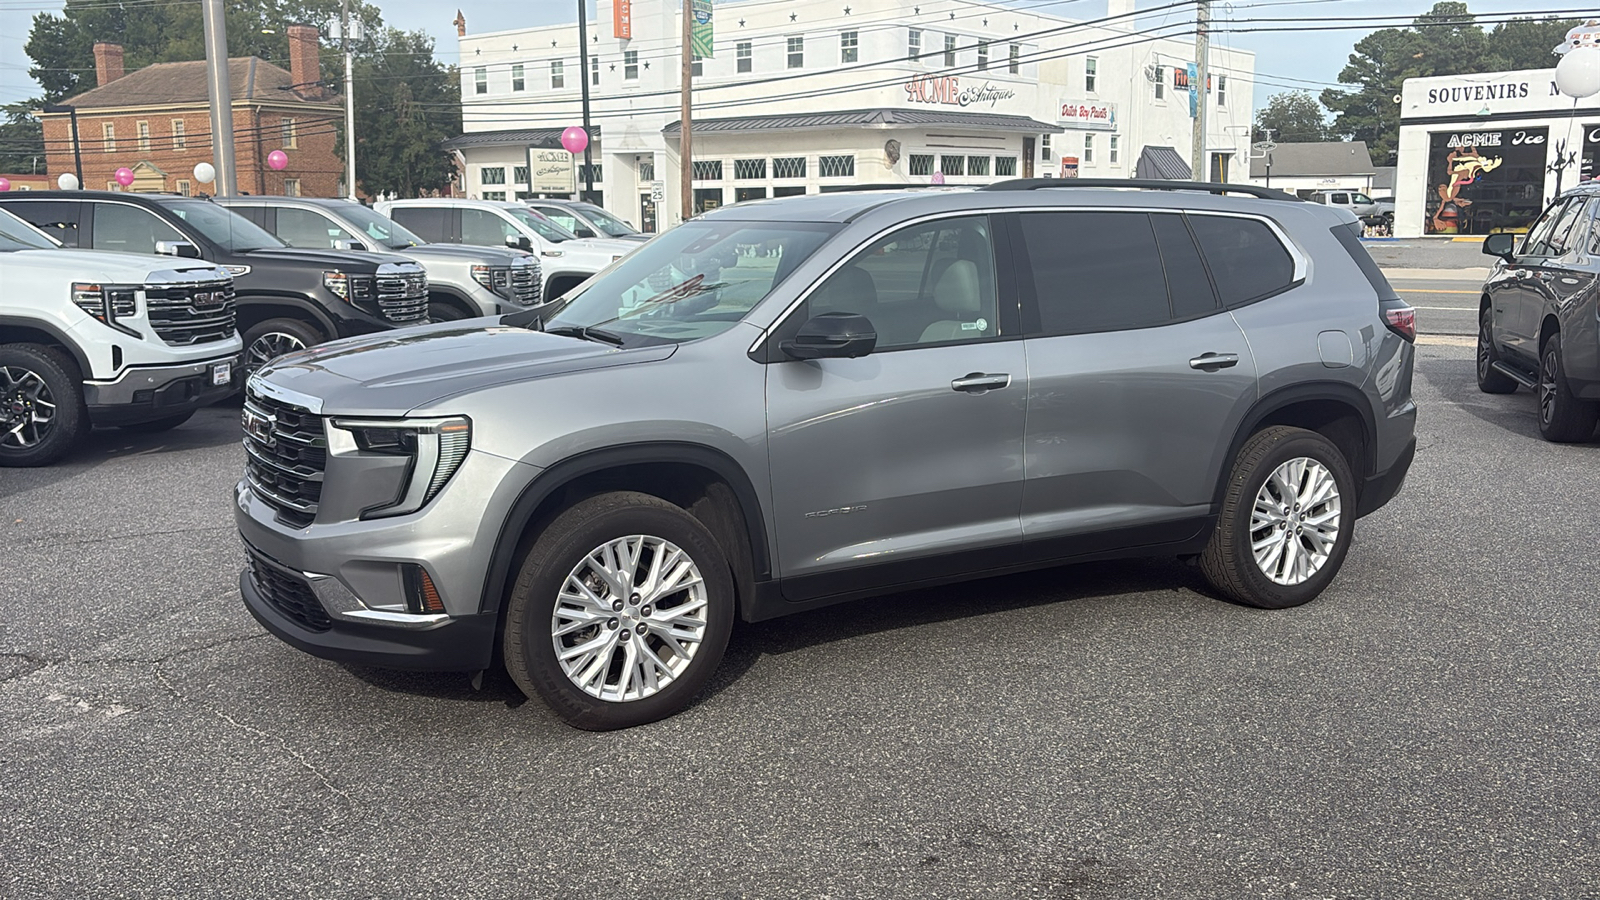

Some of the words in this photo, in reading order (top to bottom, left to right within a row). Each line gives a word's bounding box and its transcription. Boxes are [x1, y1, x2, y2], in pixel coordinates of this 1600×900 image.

[905, 73, 959, 105] ACME
[971, 80, 1016, 108] Antiques
[1428, 82, 1529, 104] SOUVENIRS
[1062, 104, 1077, 117] Dutch
[1079, 105, 1089, 120] Boy
[1090, 106, 1107, 119] Paints
[1447, 133, 1502, 148] ACME
[1511, 131, 1546, 146] Ice
